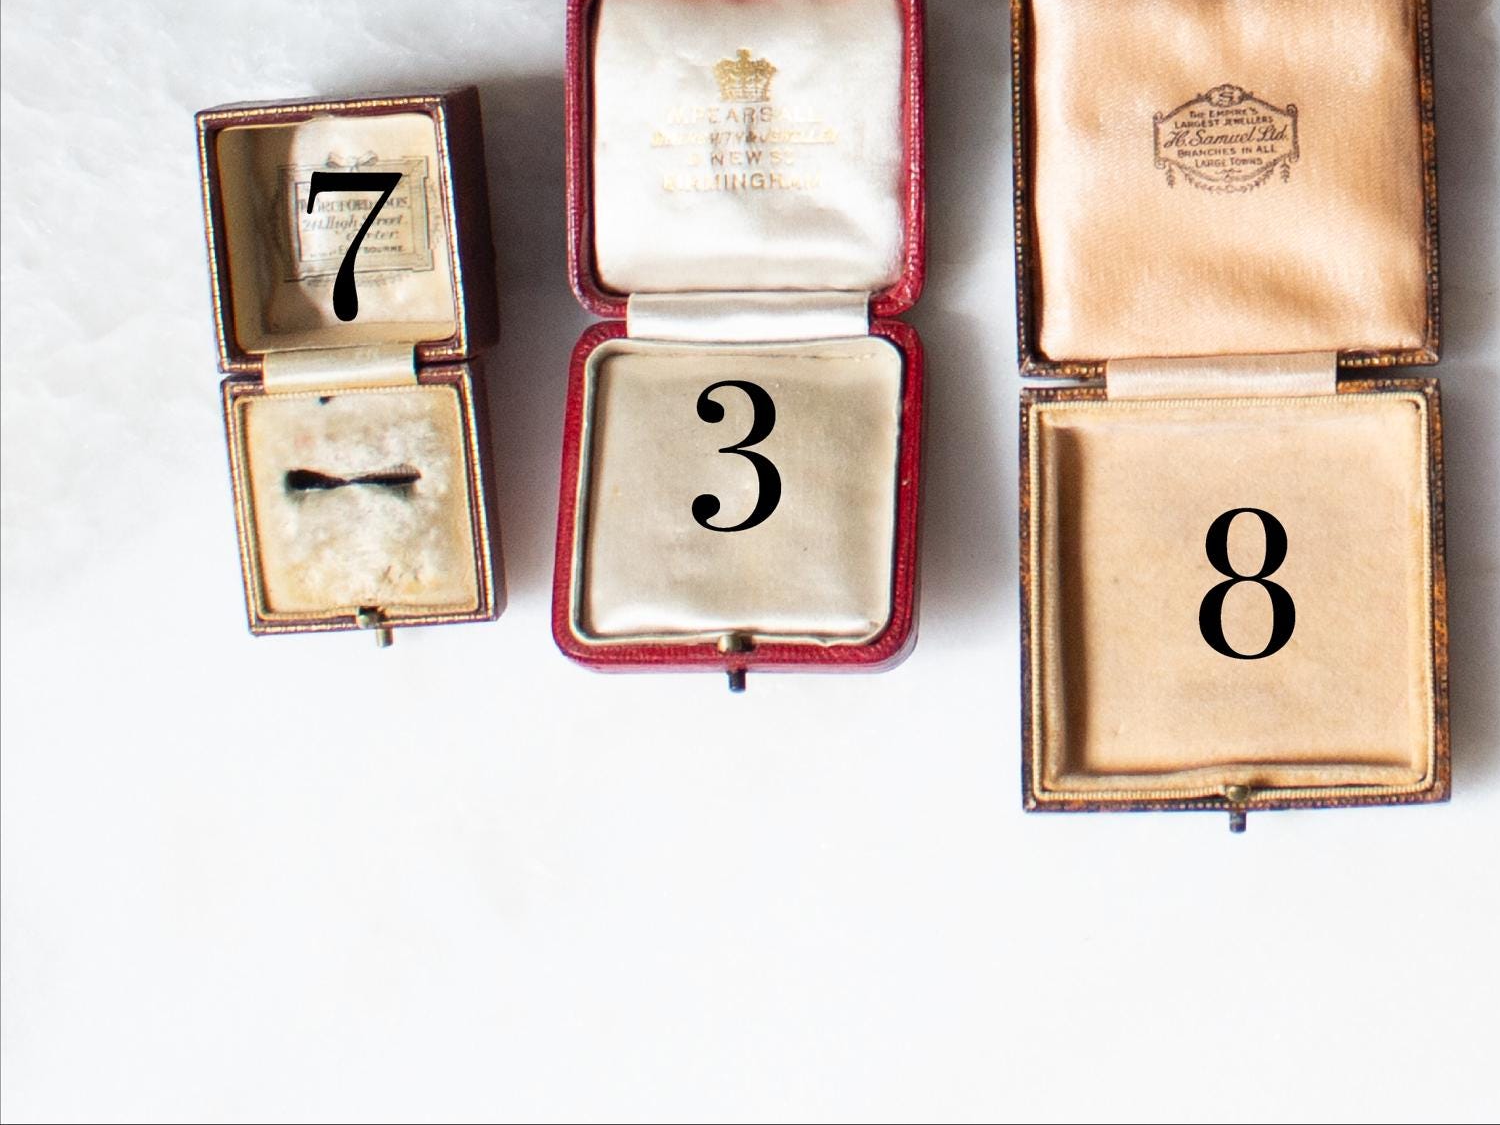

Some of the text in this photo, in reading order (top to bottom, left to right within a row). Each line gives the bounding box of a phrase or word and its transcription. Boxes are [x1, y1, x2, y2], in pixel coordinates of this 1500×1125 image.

[1174, 115, 1275, 130] LARGEST JEWELLERS
[1189, 125, 1256, 147] Samuel
[709, 150, 762, 166] NEW
[1177, 144, 1278, 159] BRANCHES IN ALL
[1195, 156, 1264, 170] LARGE TOWNS
